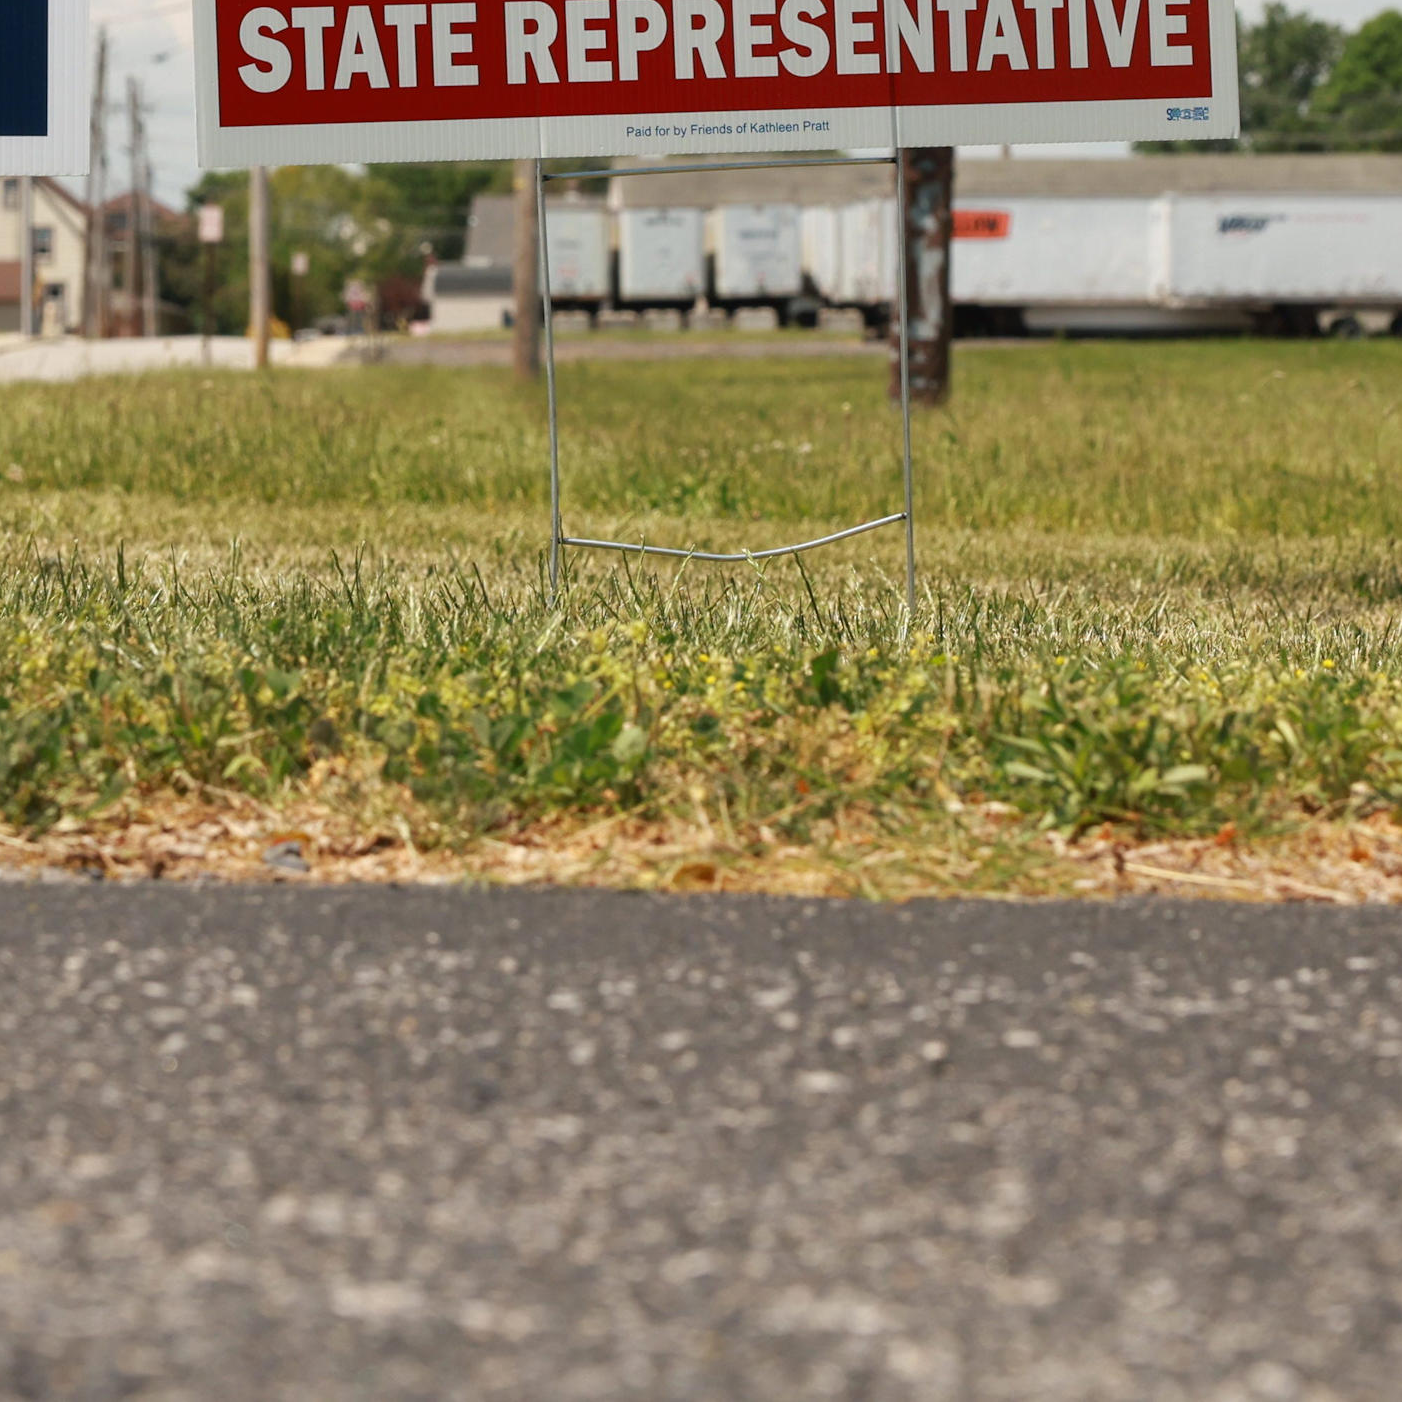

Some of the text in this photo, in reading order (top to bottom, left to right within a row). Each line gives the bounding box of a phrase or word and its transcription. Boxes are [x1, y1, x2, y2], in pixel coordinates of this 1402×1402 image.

[238, 3, 478, 92] STATE
[626, 120, 830, 138] Paid for by Friends of Kathleen Pratt
